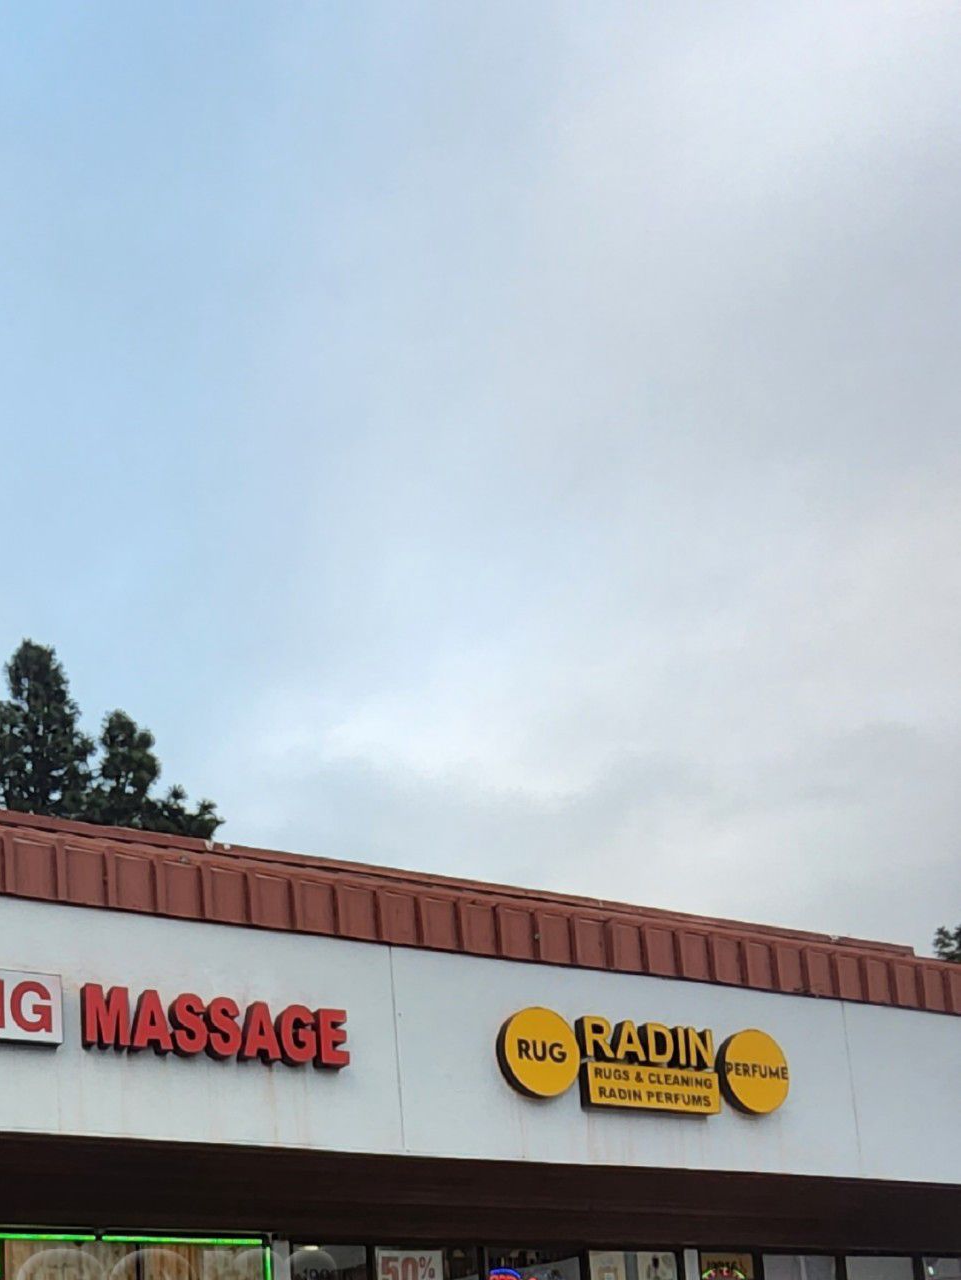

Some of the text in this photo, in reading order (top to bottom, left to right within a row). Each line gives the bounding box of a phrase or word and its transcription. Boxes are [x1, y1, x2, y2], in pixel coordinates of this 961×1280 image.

[82, 983, 350, 1069] MASSAGE
[517, 1039, 567, 1063] RUG
[580, 1016, 715, 1068] RADIN
[594, 1067, 713, 1090] RUGS & CLEANING
[726, 1061, 788, 1080] PERFUME
[598, 1086, 712, 1108] RADIN PERFUMS
